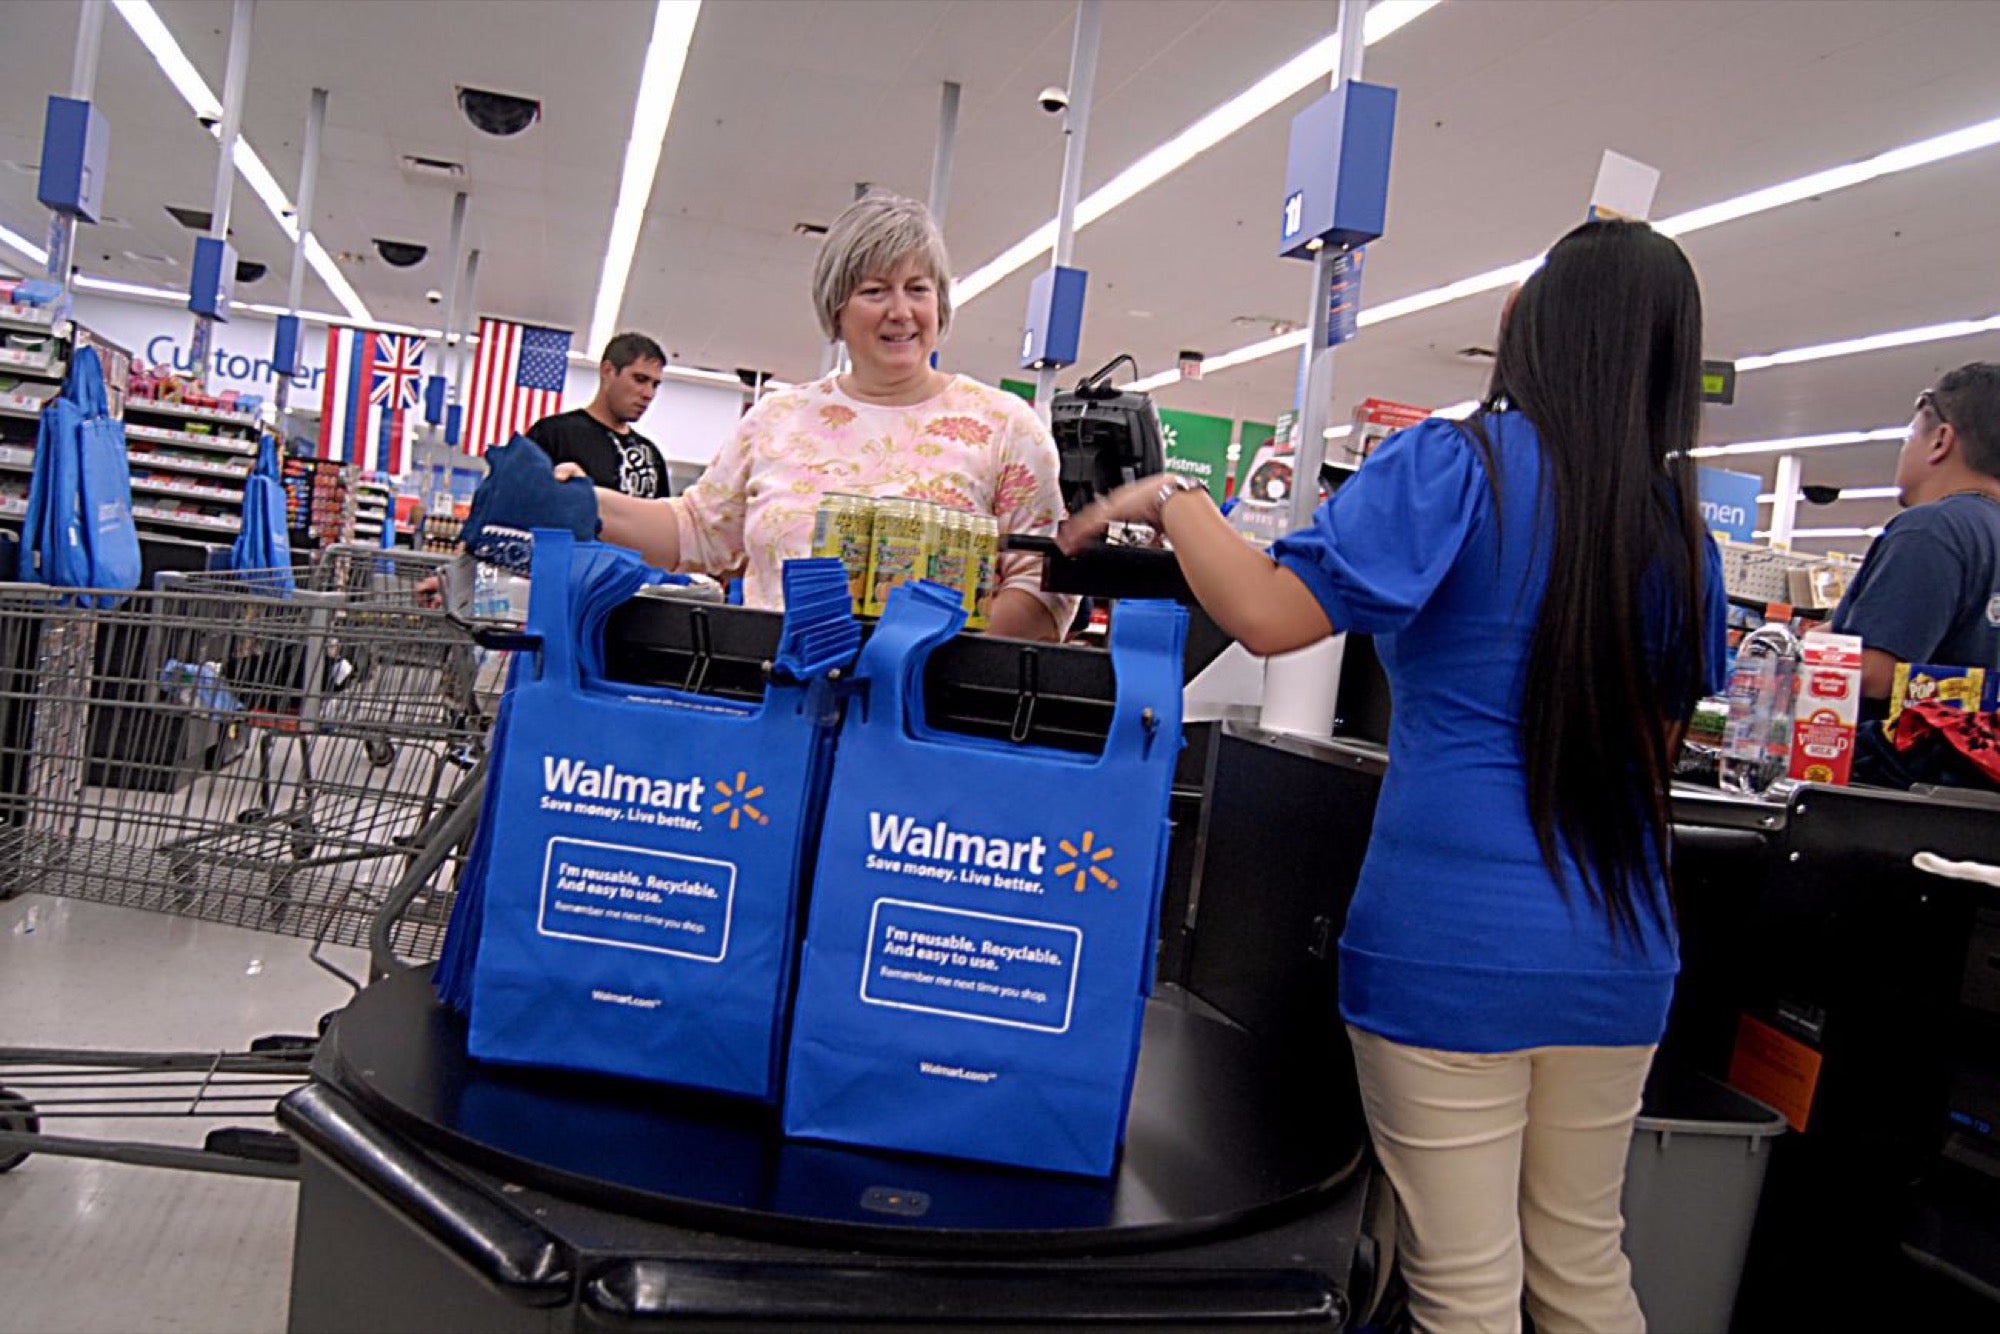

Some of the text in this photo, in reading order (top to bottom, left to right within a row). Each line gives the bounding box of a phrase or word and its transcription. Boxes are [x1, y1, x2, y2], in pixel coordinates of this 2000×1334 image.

[147, 336, 326, 389] Cutomer
[1165, 456, 1212, 475] ristmas
[1699, 502, 1745, 526] men
[543, 756, 705, 812] Walmart
[540, 795, 702, 831] Save money. Live better.
[870, 812, 1046, 875] Walmart
[557, 877, 663, 904] And easy to use.
[559, 862, 718, 899] I'm reusable. Recyclable.
[866, 854, 1045, 895] Save money. Live better.
[554, 901, 605, 917] Remember
[605, 909, 622, 919] me
[622, 911, 643, 923] next
[643, 914, 664, 926] time
[664, 918, 681, 930] you
[884, 941, 1000, 972] And easy to use.
[885, 925, 1063, 966] I'm reusable. Recyclable.
[879, 965, 935, 984] Remember
[935, 976, 952, 987] me
[953, 979, 976, 991] next
[976, 982, 1000, 995] time
[1000, 985, 1020, 998] you
